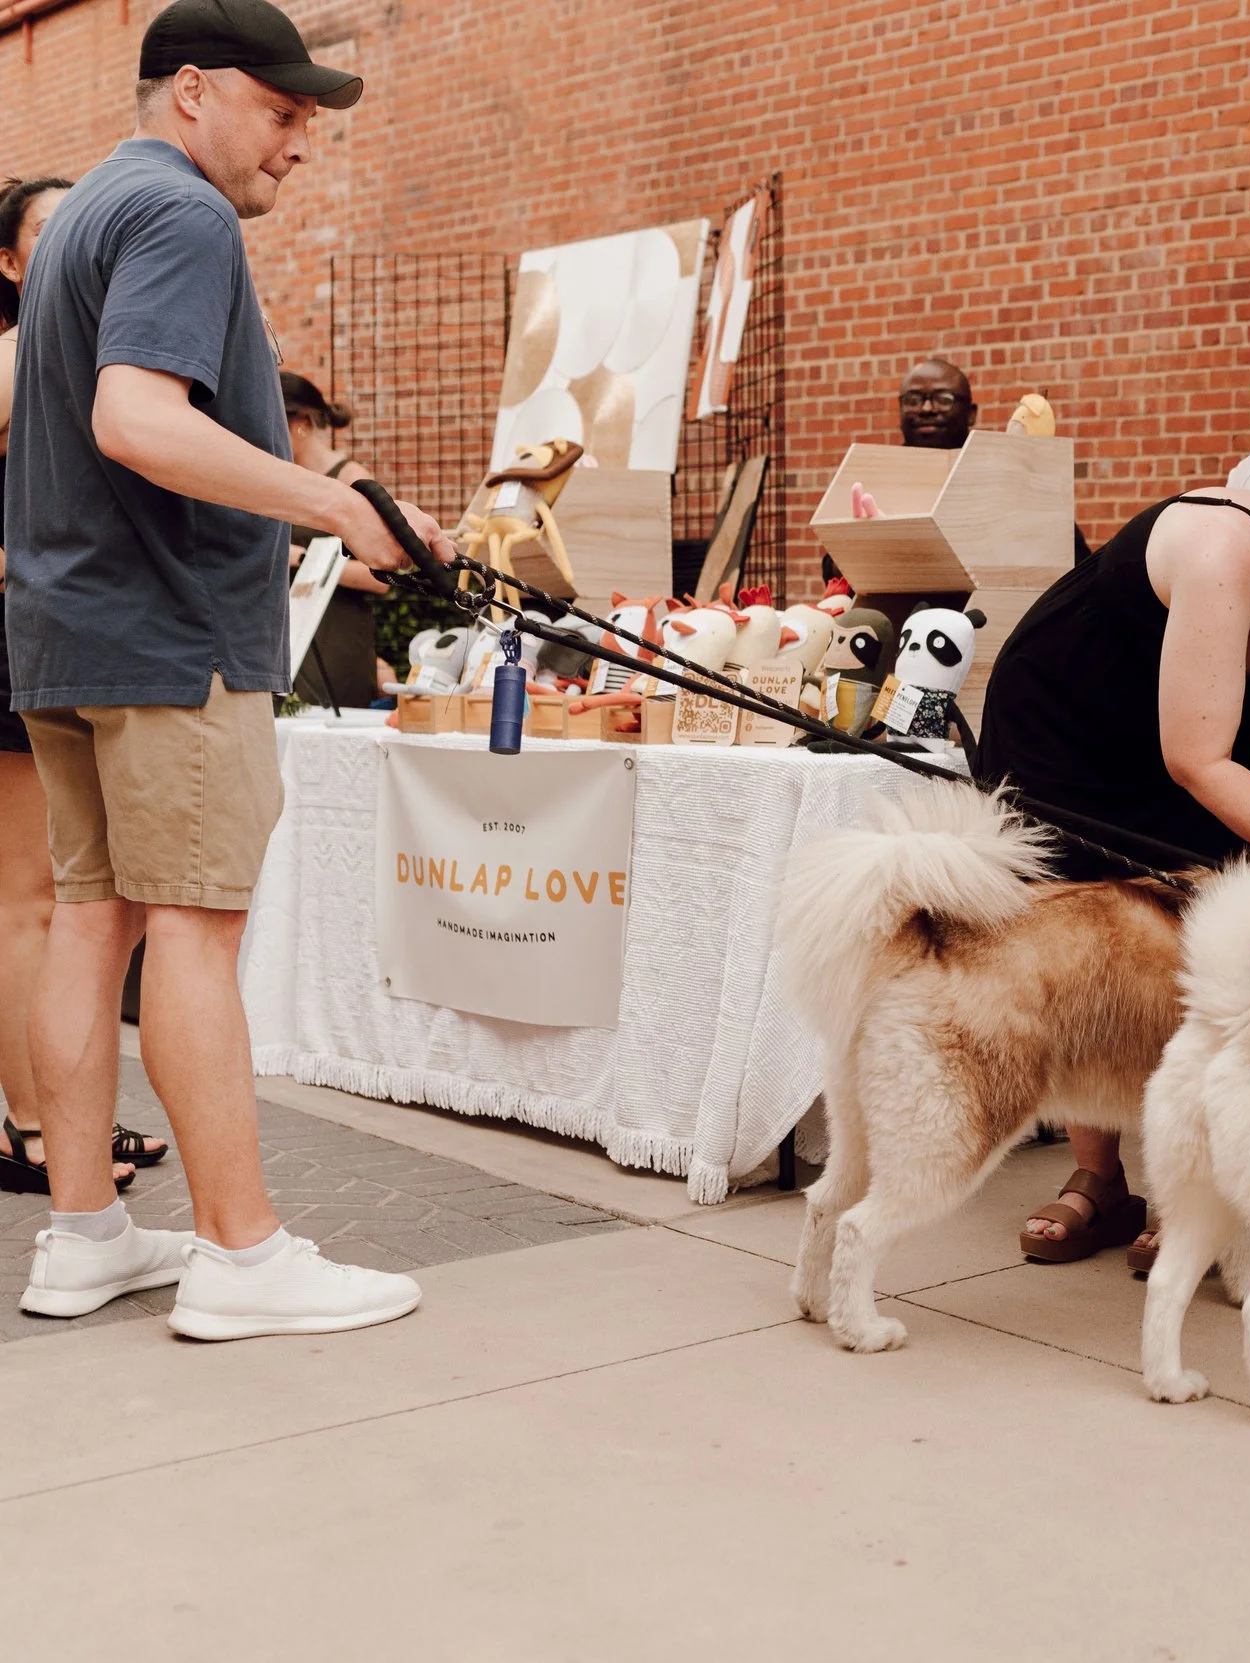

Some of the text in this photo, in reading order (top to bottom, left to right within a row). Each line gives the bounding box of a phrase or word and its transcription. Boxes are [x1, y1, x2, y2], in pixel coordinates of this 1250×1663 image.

[752, 676, 797, 686] DUNLAP
[759, 686, 788, 695] LOVE
[884, 686, 897, 698] MEET
[482, 822, 526, 835] EST. 2007
[396, 852, 627, 906] DUNLAP LOVE
[436, 917, 556, 943] HANDMADE IMAGINATION
